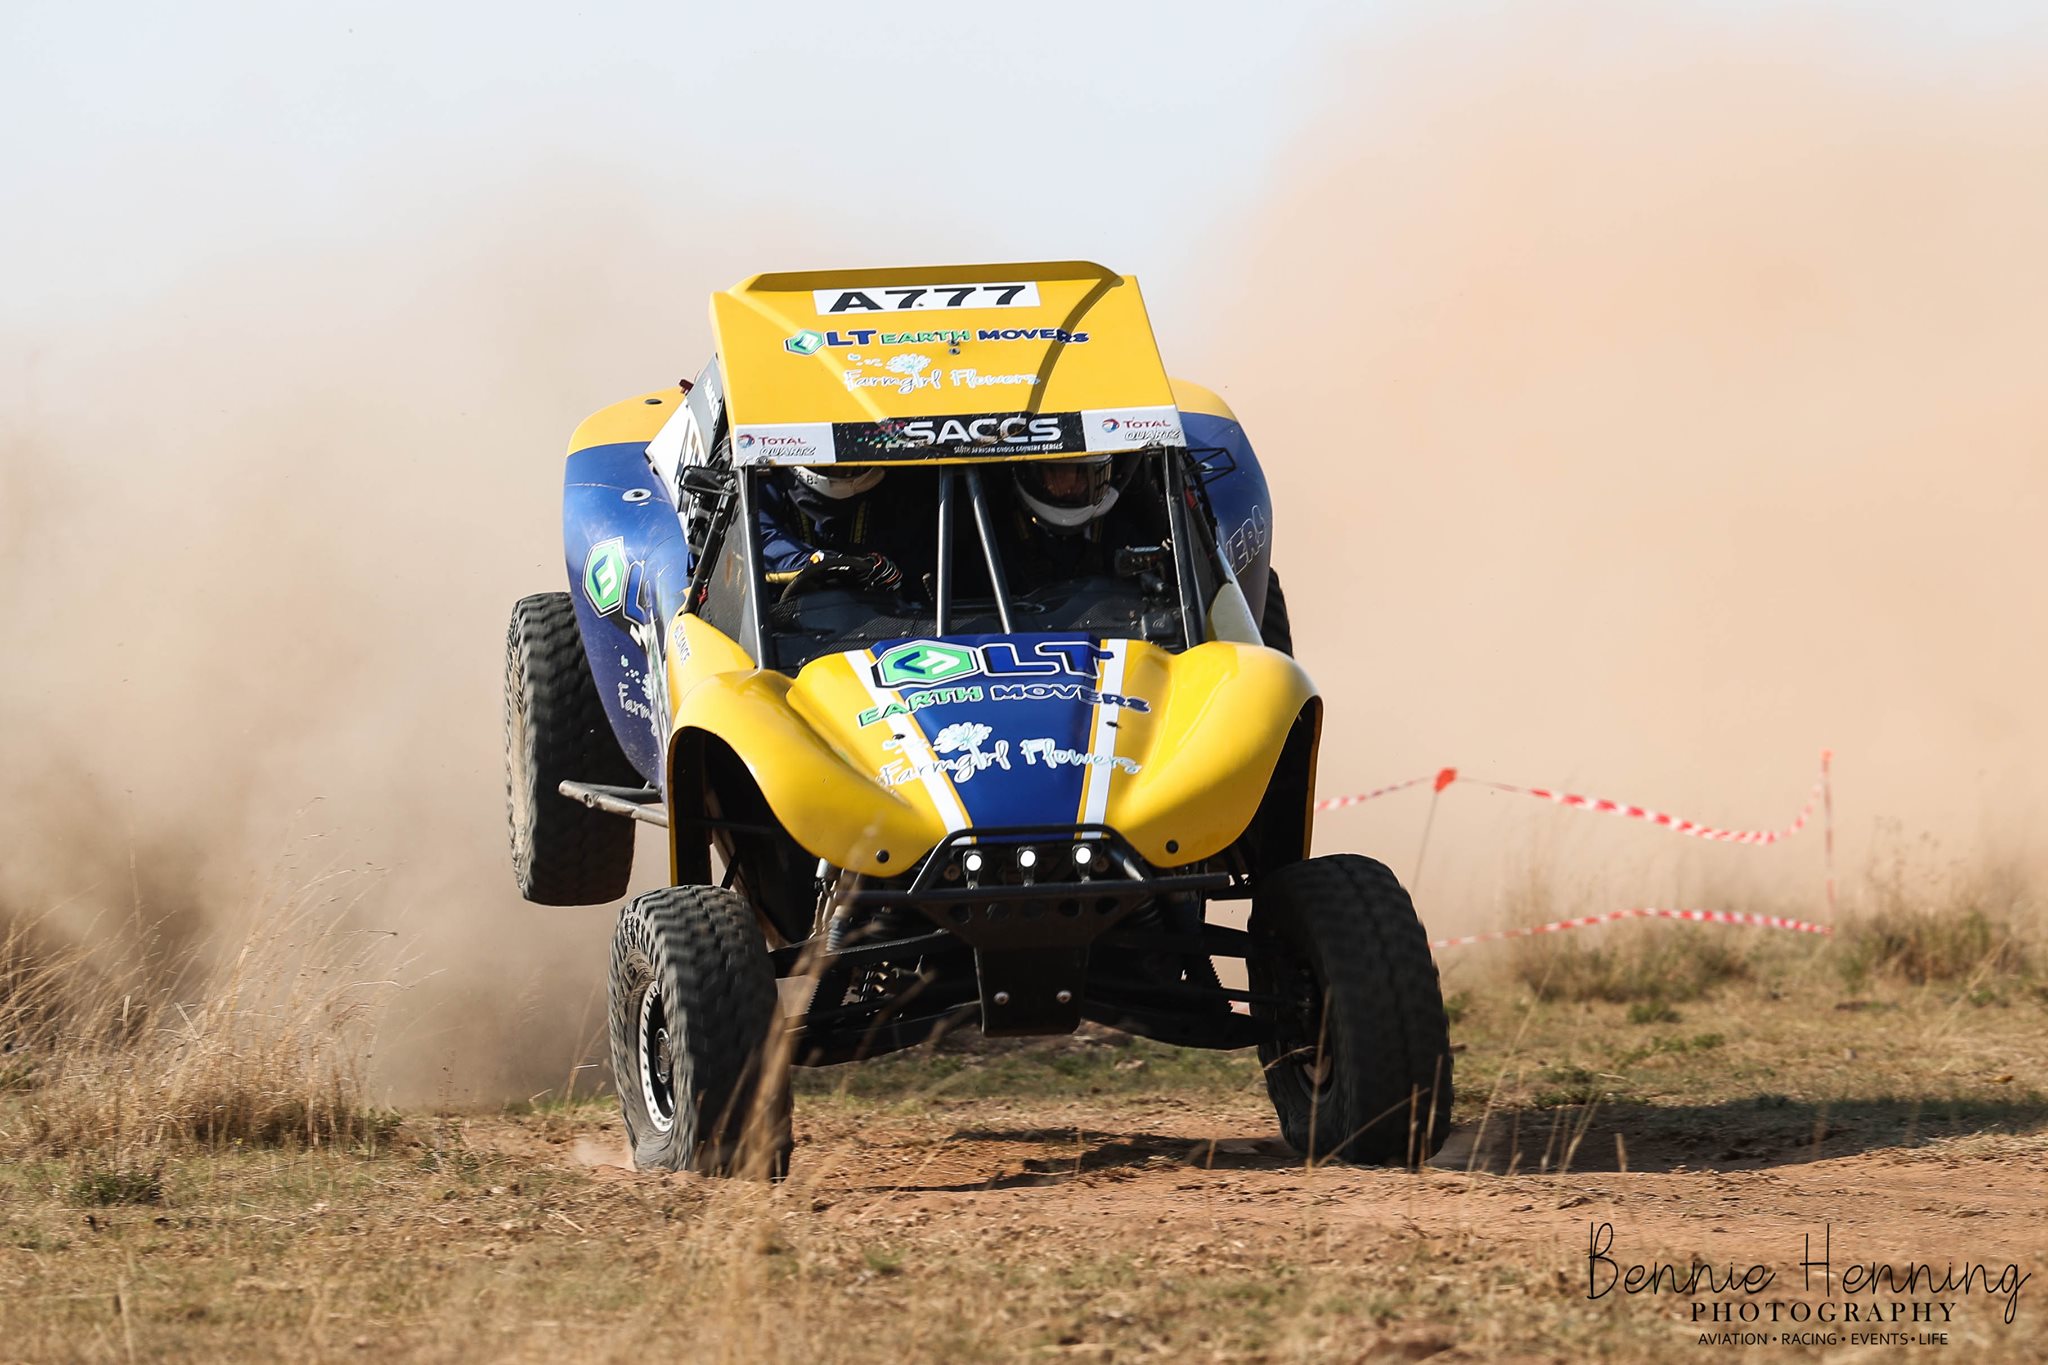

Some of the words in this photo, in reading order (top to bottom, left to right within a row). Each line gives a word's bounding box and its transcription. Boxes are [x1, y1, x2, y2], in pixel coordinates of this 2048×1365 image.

[829, 285, 1026, 312] A777
[826, 329, 877, 347] LT
[880, 330, 971, 345] EARTH
[977, 328, 1090, 344] MOVERS
[843, 369, 942, 394] Farmgirl
[950, 369, 1041, 388] Flowers
[904, 417, 1062, 445] SACCS
[1123, 419, 1171, 428] TOTAL
[1125, 429, 1180, 441] QUARTZ
[758, 436, 807, 446] TOTAL
[760, 446, 817, 457] QUARTZ
[978, 642, 1114, 678] LT
[858, 686, 984, 728] EARTH
[990, 683, 1151, 714] MOVERS
[878, 740, 1011, 783] Farmgirl
[1020, 738, 1142, 775] Flowers
